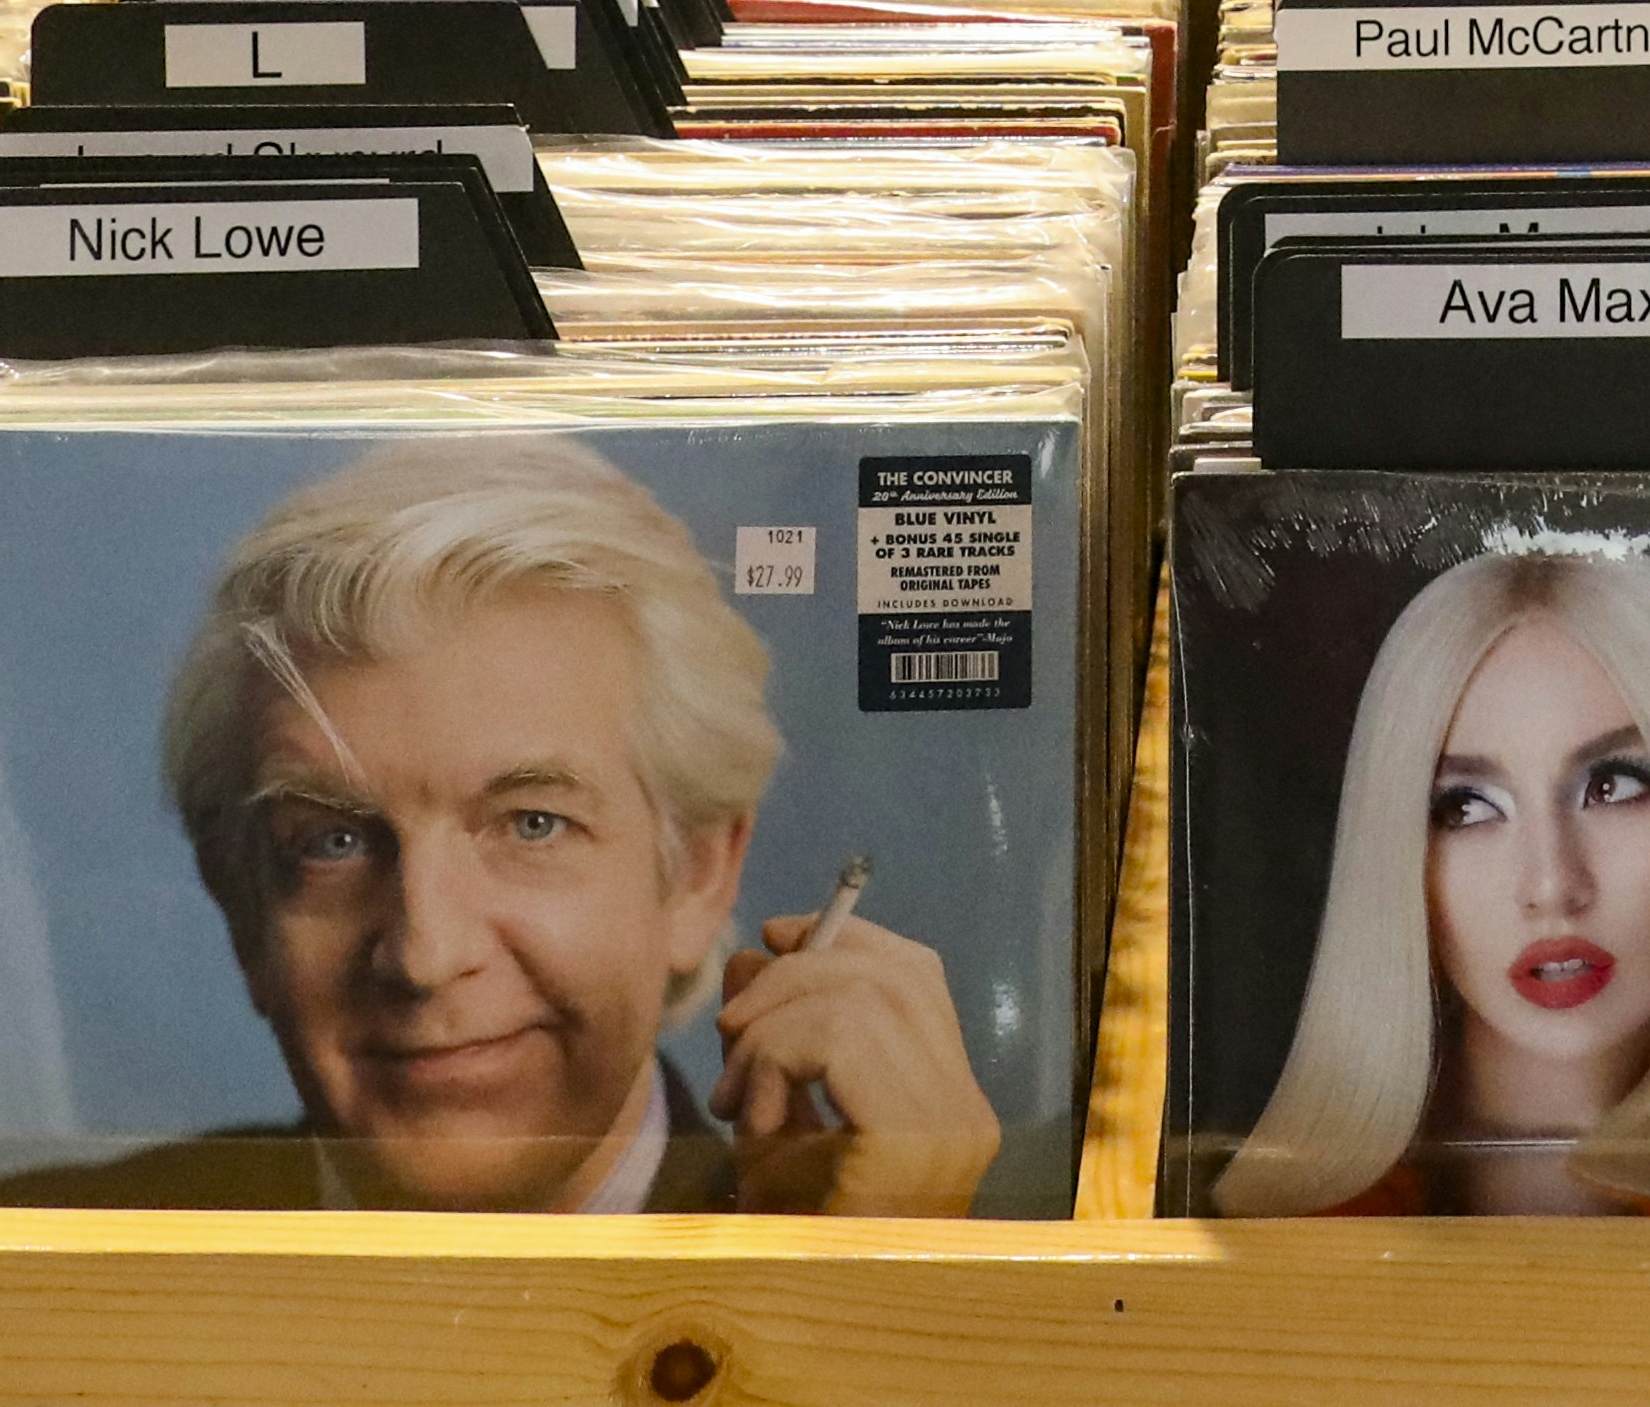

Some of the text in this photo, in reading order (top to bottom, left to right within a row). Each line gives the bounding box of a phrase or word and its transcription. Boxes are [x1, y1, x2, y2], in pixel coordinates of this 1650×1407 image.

[1353, 17, 1452, 58] Paul
[250, 31, 283, 79] L
[68, 213, 327, 262] Nick Lowe
[1438, 277, 1538, 325] Ava
[876, 470, 1014, 487] THE CONVINCER
[900, 488, 1019, 504] Anniversary Edition
[894, 510, 997, 527] BLUE VINYL
[767, 530, 804, 545] 1021
[885, 531, 1021, 546] BONUS 45 SINGLE
[875, 544, 1016, 559] OF 3 RARE TRACKS
[746, 564, 804, 588] $27.99
[890, 564, 1001, 578] REMASTERED FROM
[899, 577, 991, 592] ORIGINAL TAPES
[876, 596, 1014, 609] INCLUDES DOWNLOAD
